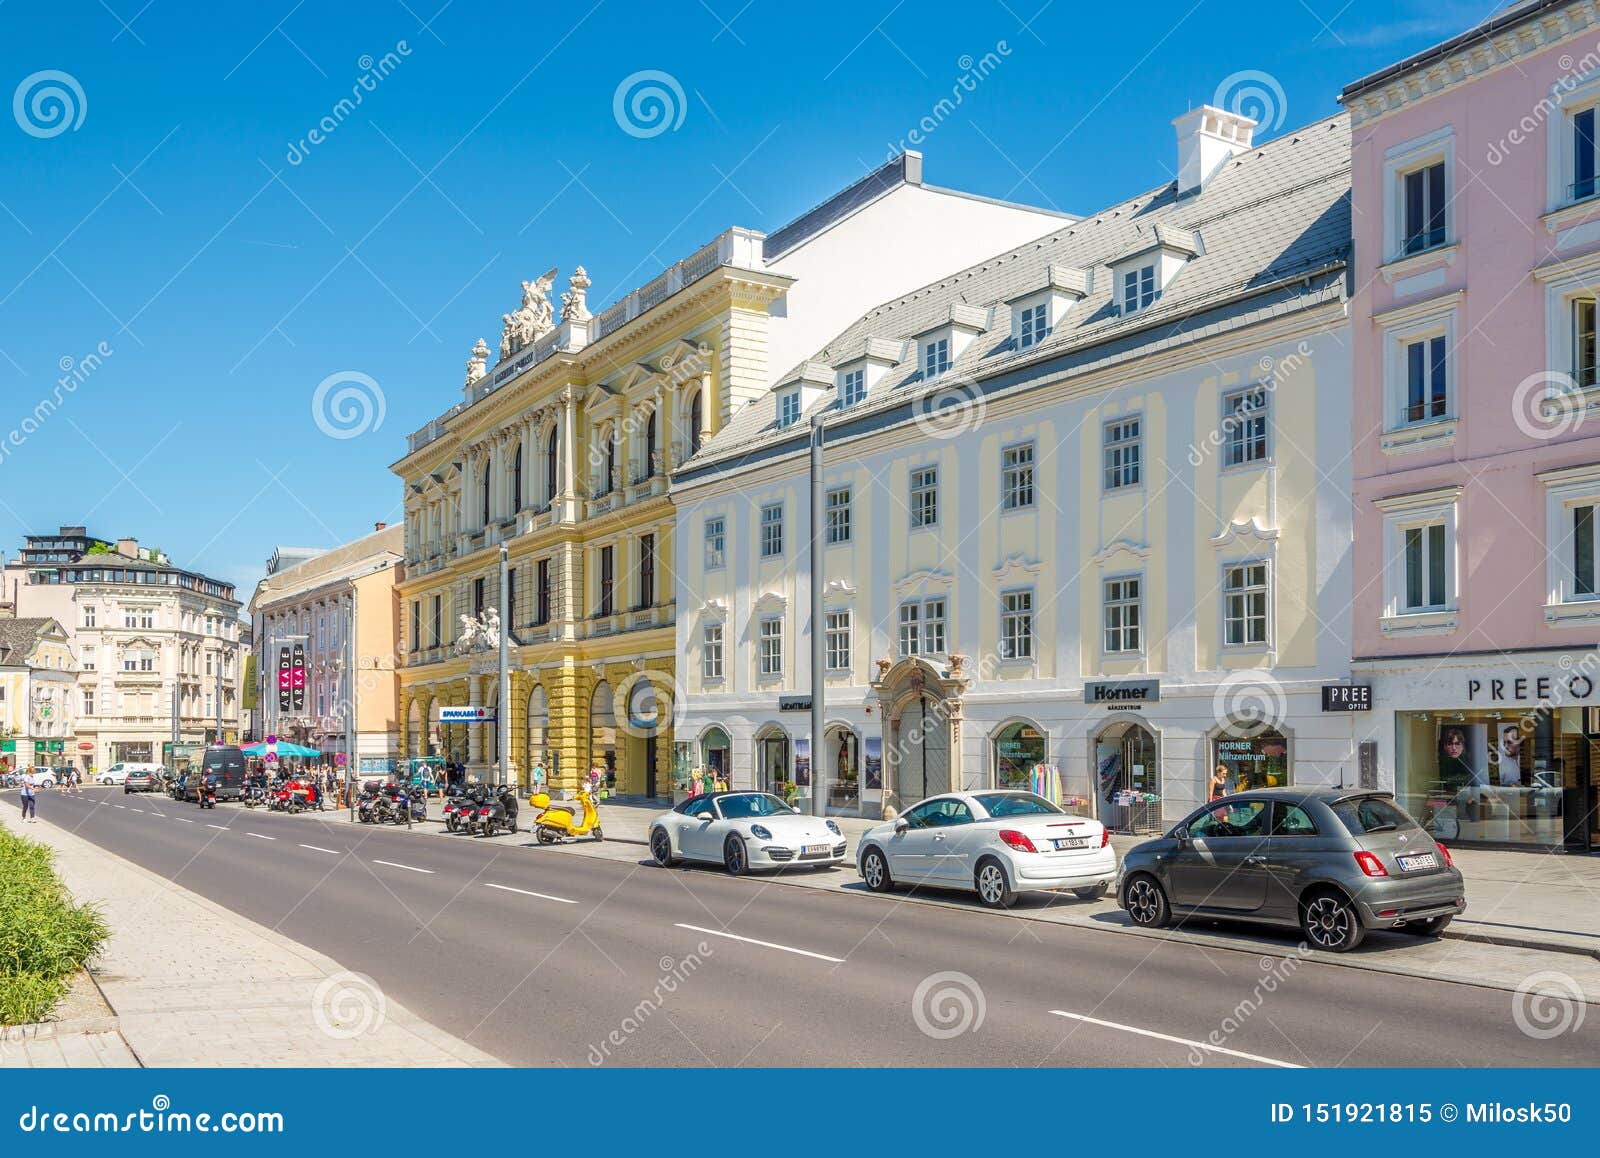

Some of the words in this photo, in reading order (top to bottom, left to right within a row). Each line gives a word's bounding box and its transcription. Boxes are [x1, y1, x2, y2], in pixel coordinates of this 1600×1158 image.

[281, 653, 290, 706] ARKADE
[294, 650, 303, 705] ARKADE
[1094, 686, 1149, 700] Horner
[1331, 687, 1368, 702] PREE
[1469, 677, 1550, 700] PREE
[1218, 741, 1252, 751] HORNER
